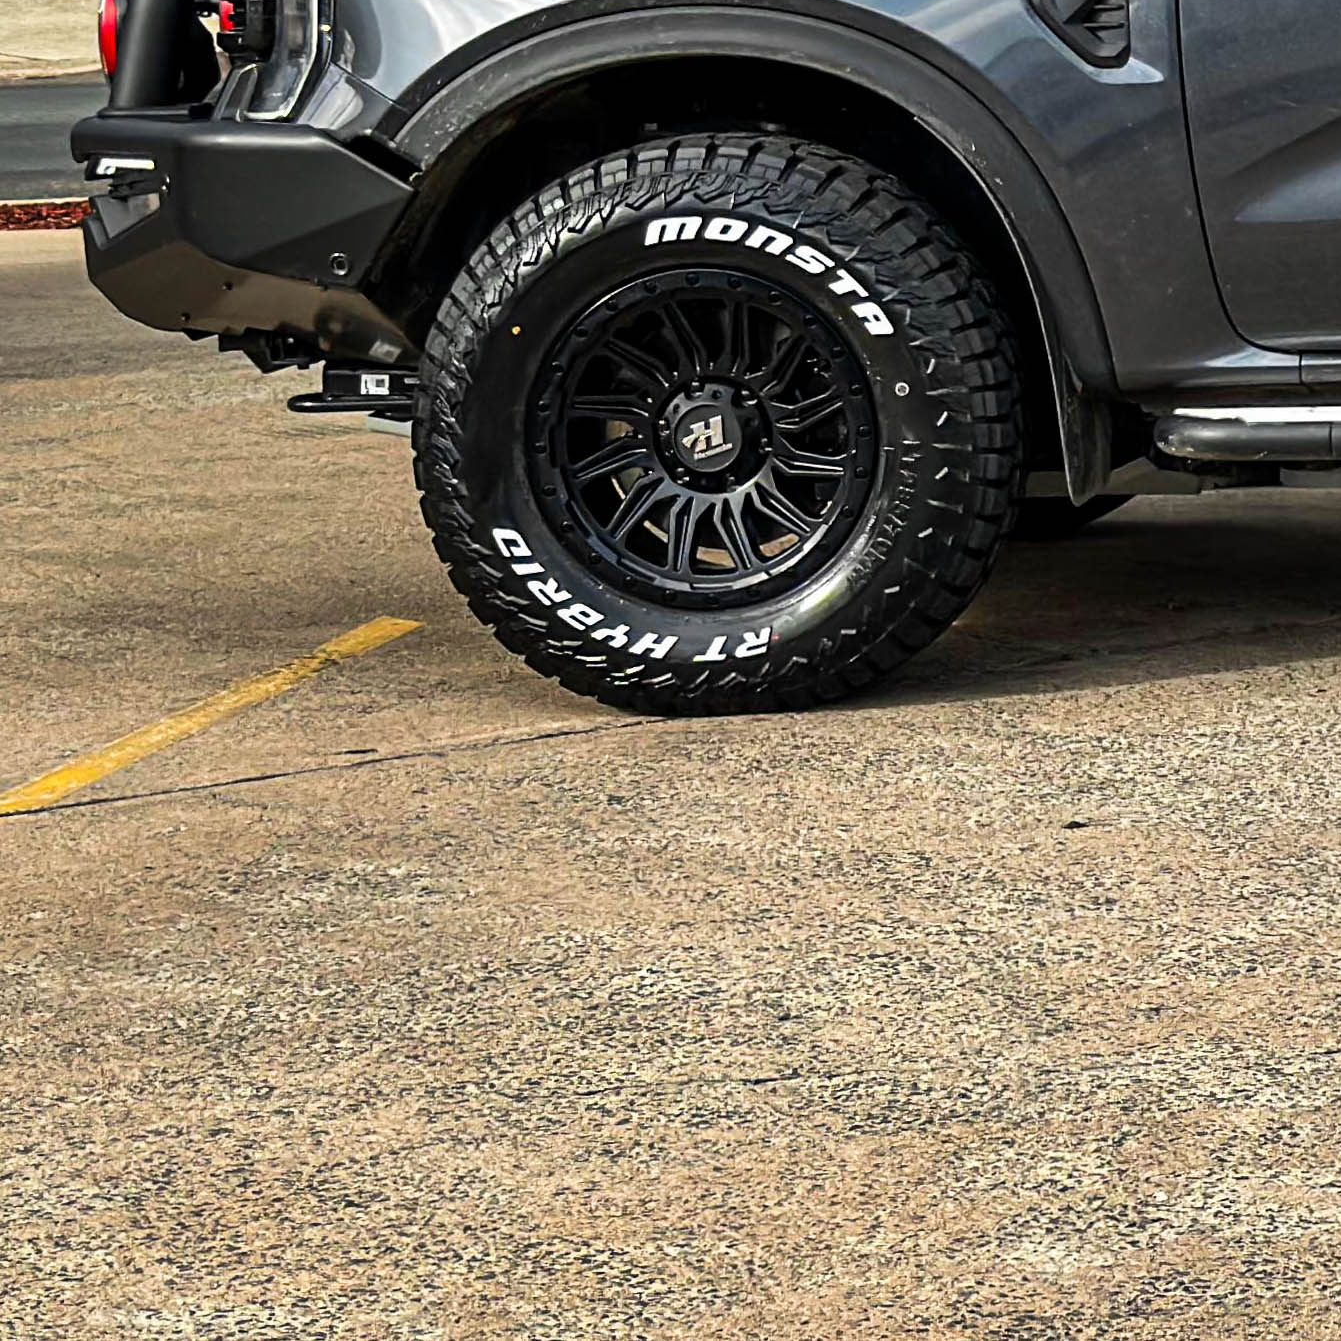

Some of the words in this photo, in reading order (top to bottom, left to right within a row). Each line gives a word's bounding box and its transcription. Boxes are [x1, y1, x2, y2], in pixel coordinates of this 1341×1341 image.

[643, 215, 896, 337] MONSTA
[491, 527, 680, 660] HYBRID
[692, 625, 774, 662] RT
